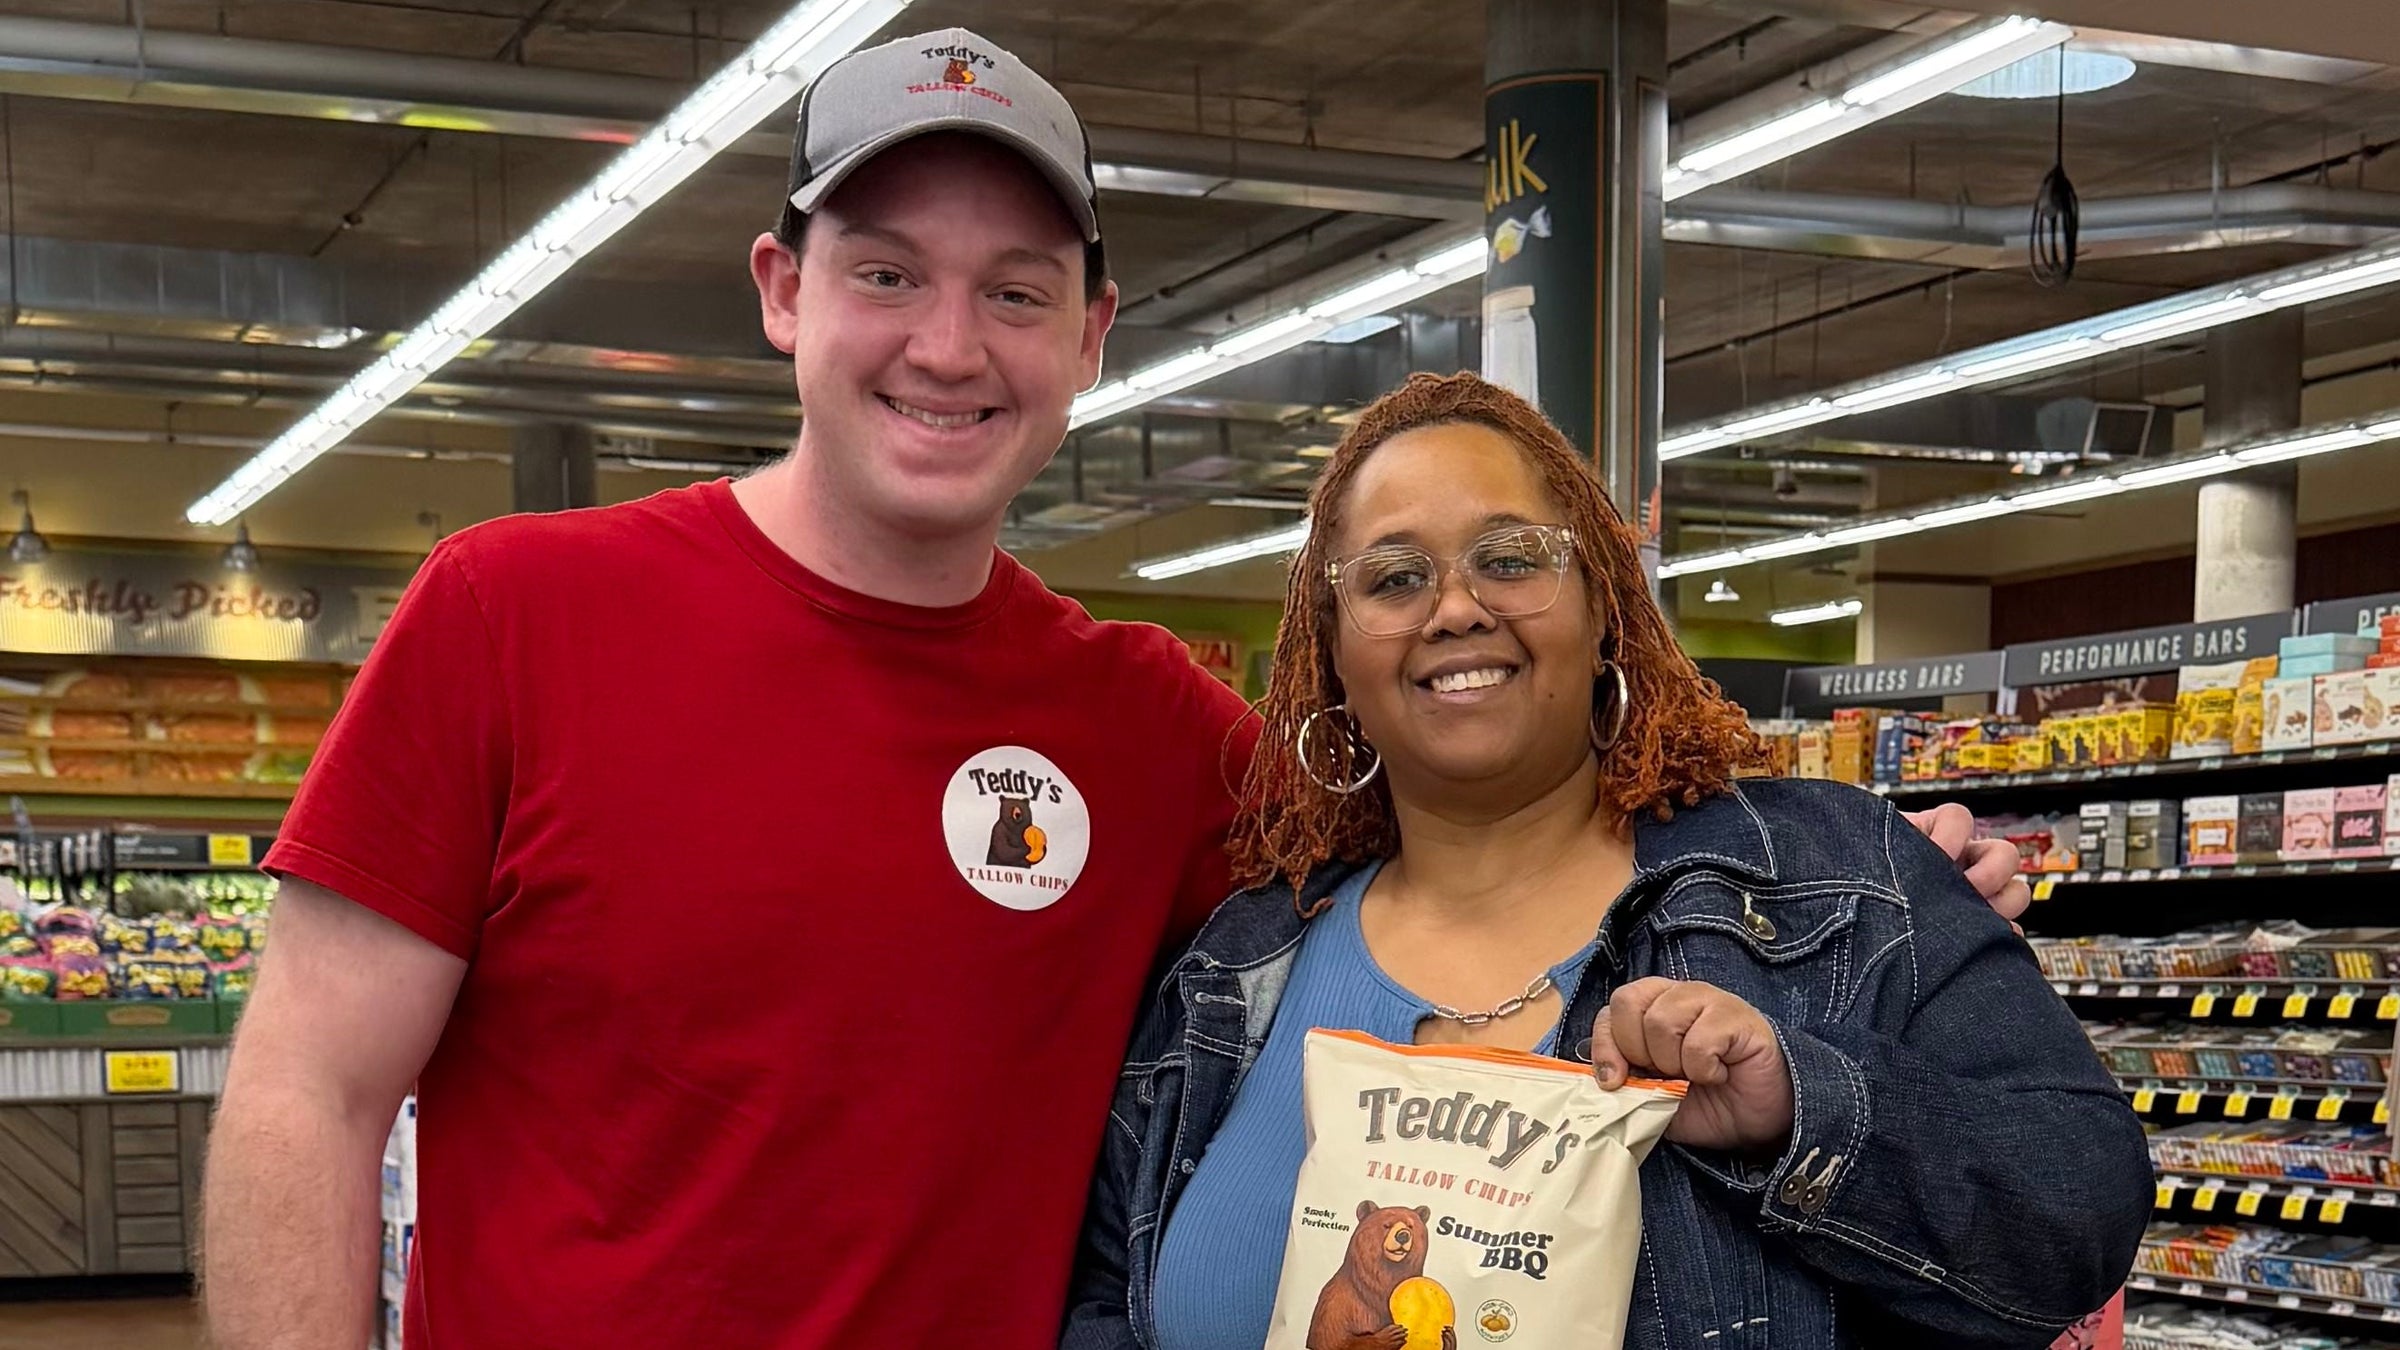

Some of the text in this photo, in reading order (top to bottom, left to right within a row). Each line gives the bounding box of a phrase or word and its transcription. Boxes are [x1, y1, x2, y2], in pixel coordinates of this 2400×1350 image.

[921, 45, 995, 69] Teddy's
[165, 580, 321, 623] Picked
[2039, 626, 2248, 676] PERFORMANCE BARS
[1819, 662, 1965, 697] WELLNESS BARS
[968, 768, 1063, 804] Teddy's
[966, 867, 1070, 891] TALLOW CHIPS
[1358, 1087, 1581, 1174] Teddy's
[1366, 1160, 1534, 1208] TALLOW CHIPS
[1301, 1217, 1350, 1232] Perfection
[1303, 1206, 1337, 1220] Smoky
[1436, 1216, 1554, 1250] Summer
[1479, 1247, 1549, 1280] BBQ
